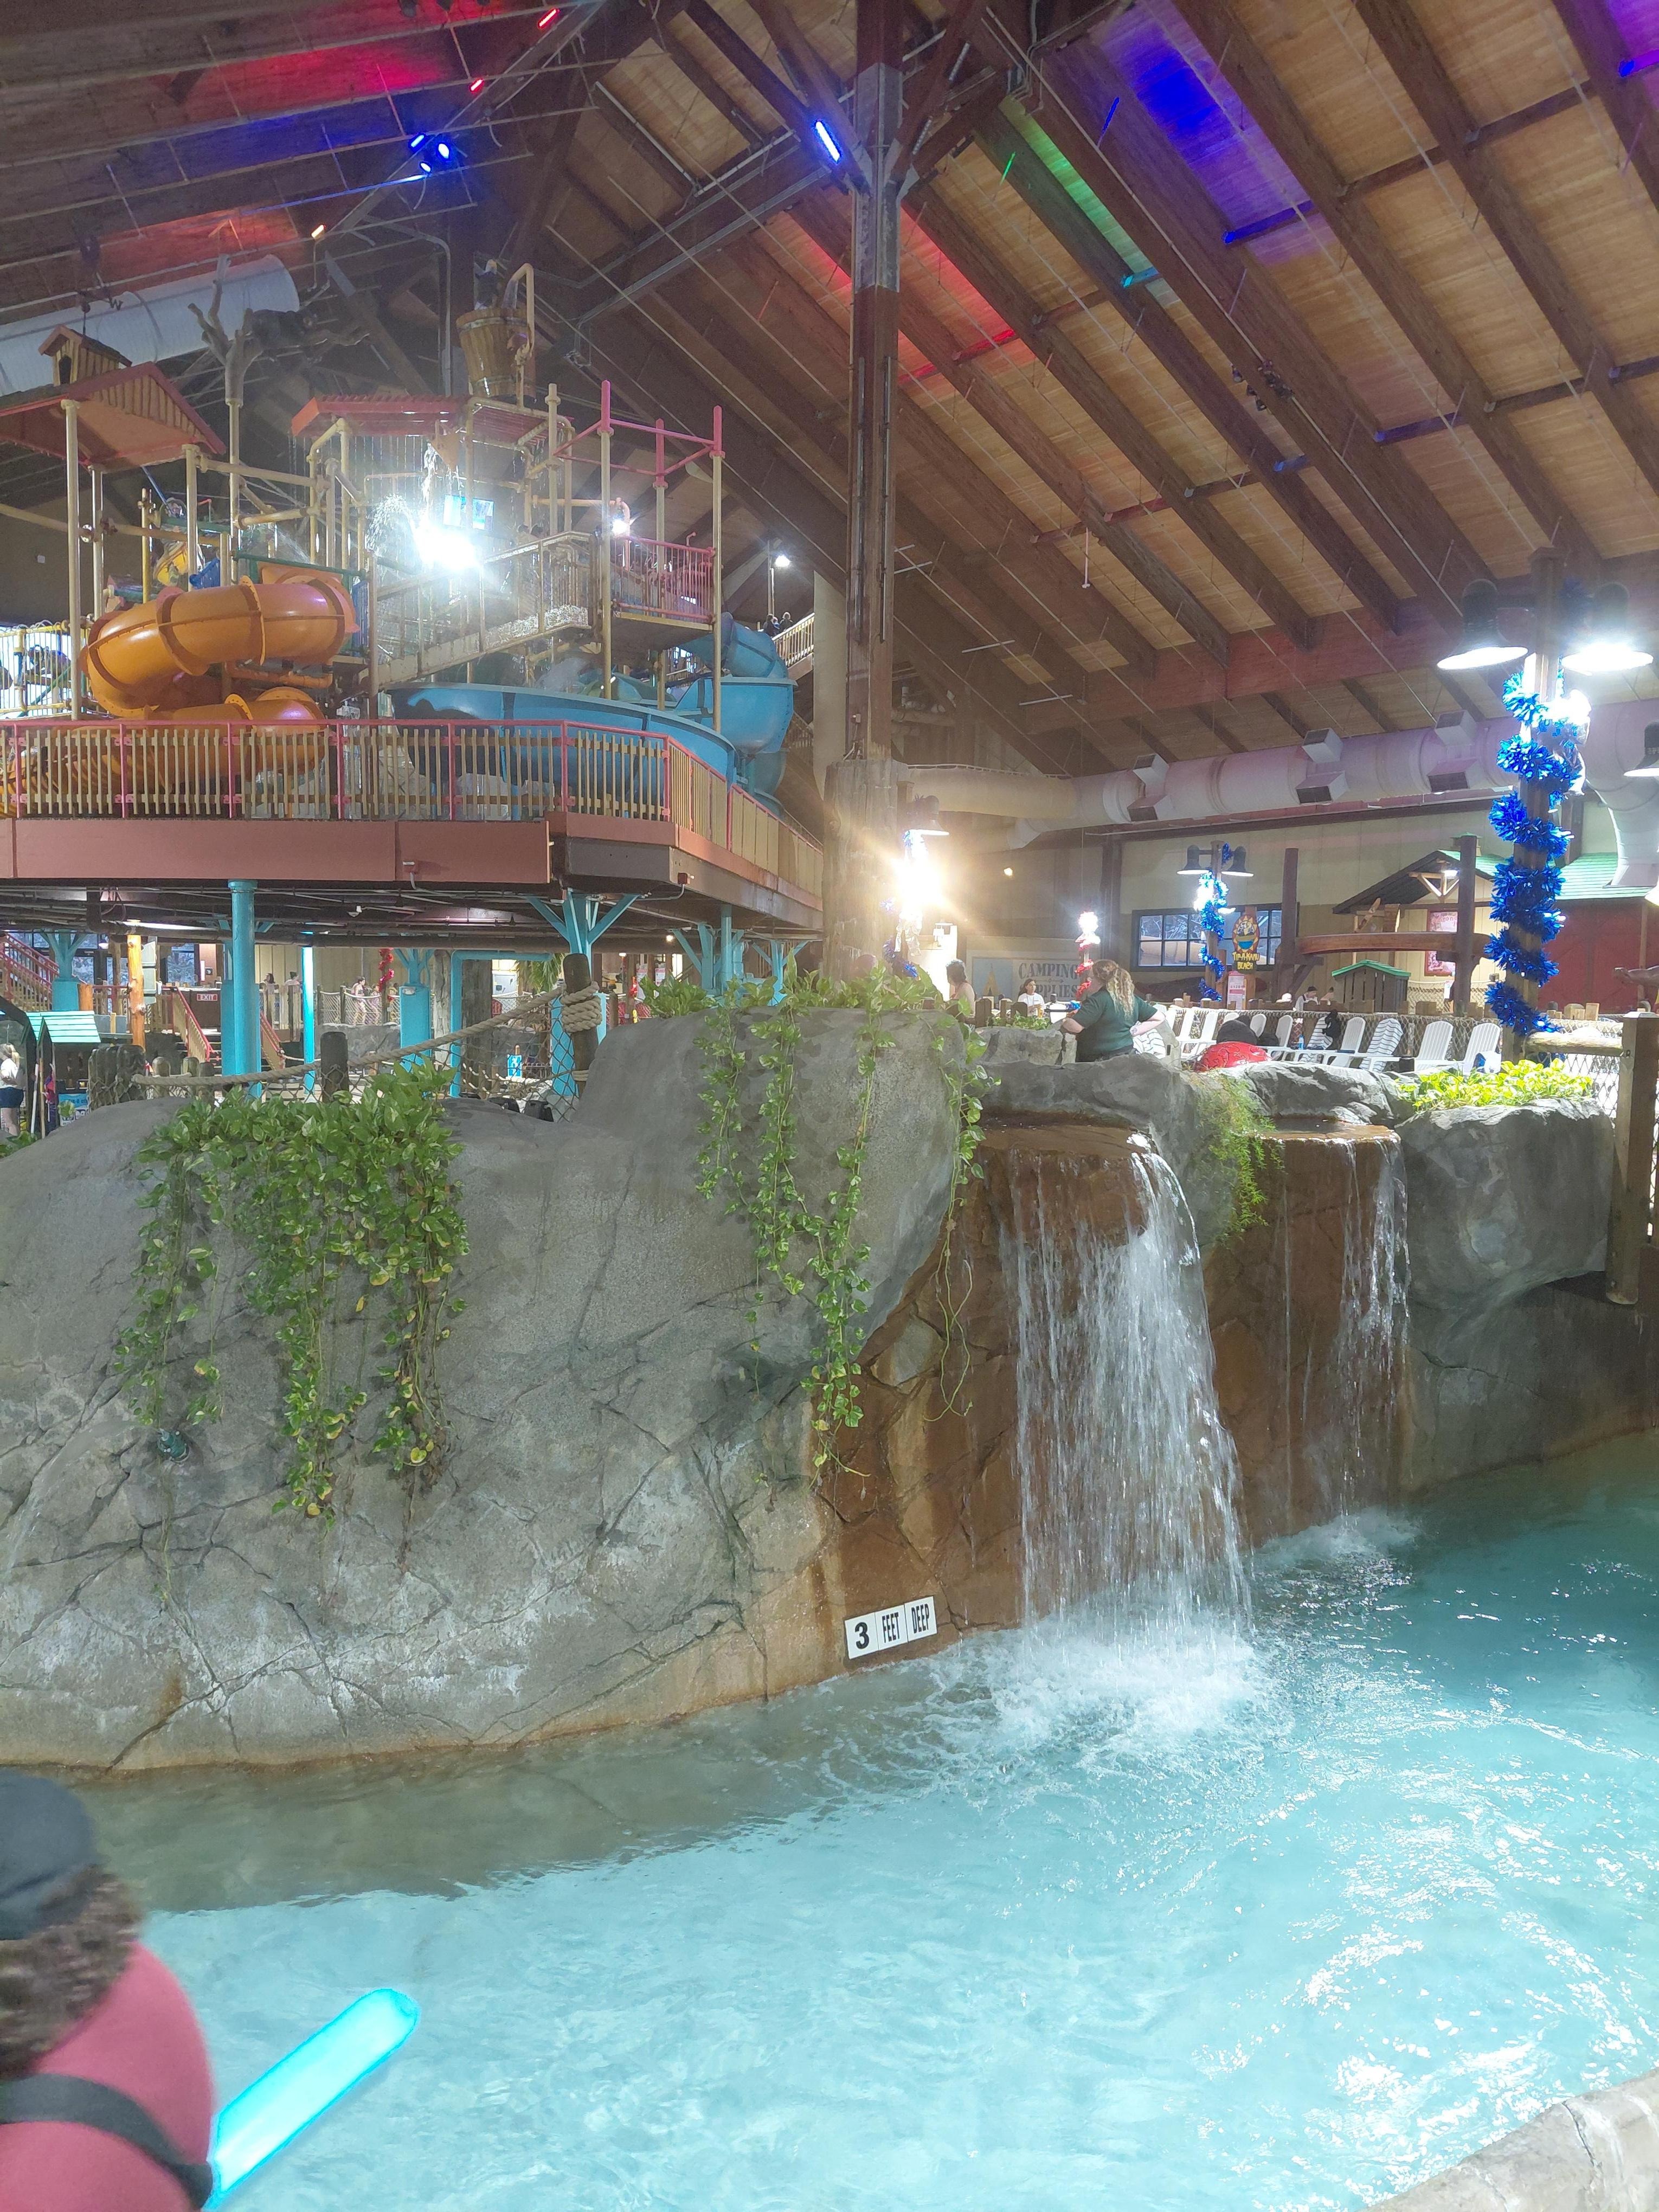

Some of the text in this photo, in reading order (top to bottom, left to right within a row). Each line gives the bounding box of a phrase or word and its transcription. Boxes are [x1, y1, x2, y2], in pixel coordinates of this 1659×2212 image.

[1019, 963, 1078, 979] CAMPING
[854, 1604, 930, 1650] 3 FEET DEEP
